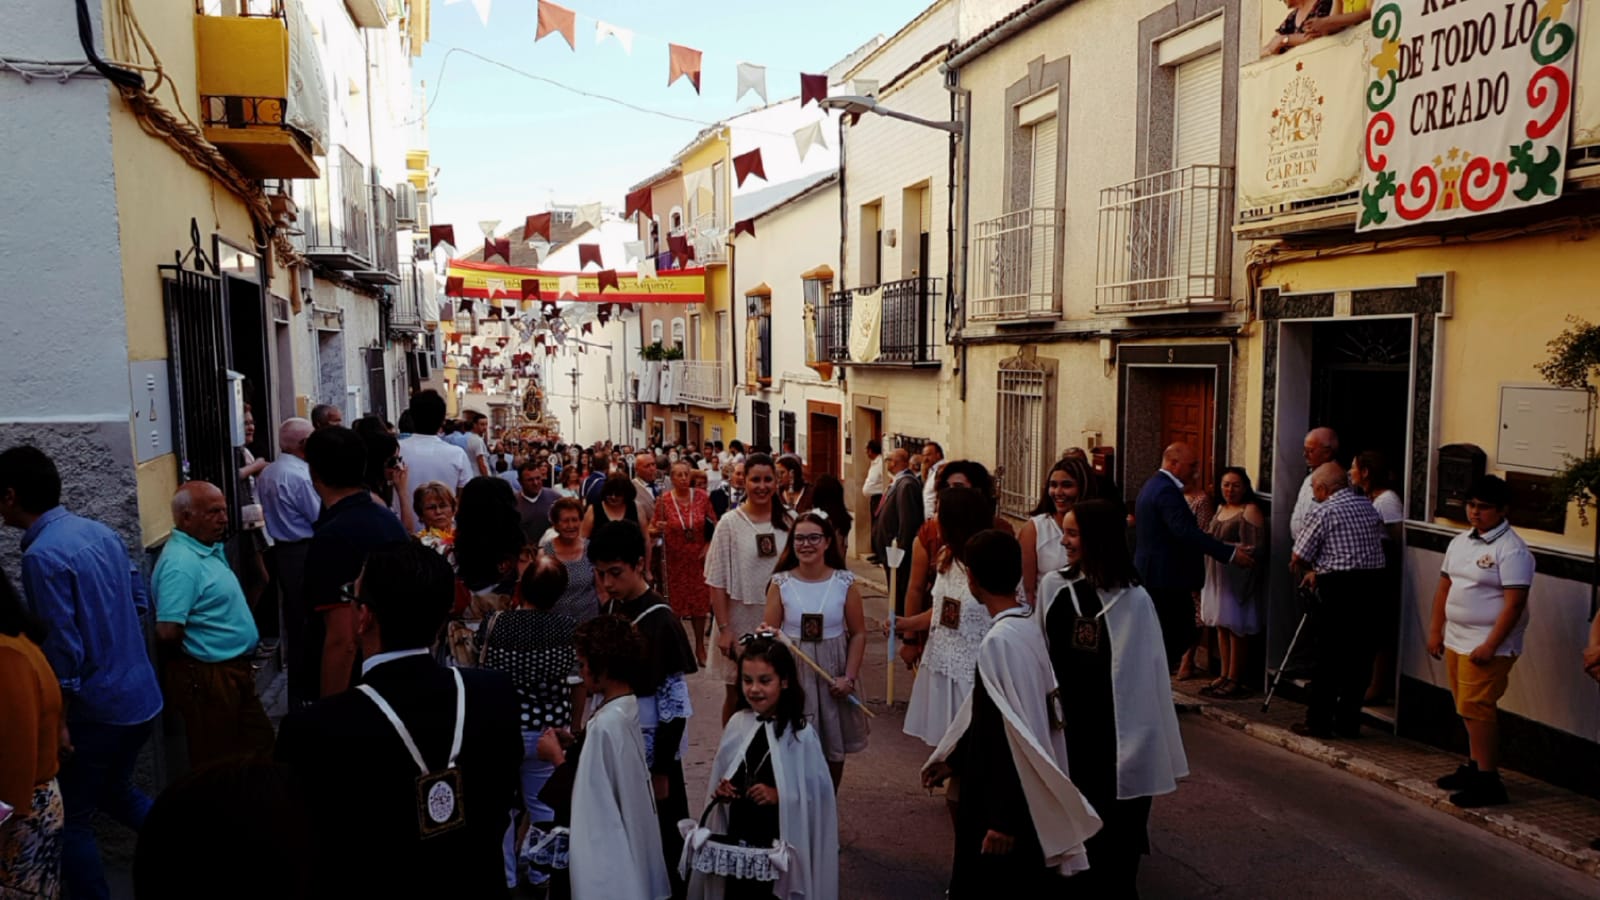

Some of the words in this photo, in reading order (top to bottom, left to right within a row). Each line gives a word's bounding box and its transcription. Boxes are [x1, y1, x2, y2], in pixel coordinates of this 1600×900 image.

[1395, 34, 1424, 83] DE
[1431, 12, 1496, 71] TODO
[1501, 0, 1538, 50] LO
[1410, 71, 1509, 136] CREADO
[1266, 159, 1317, 182] CARMEN
